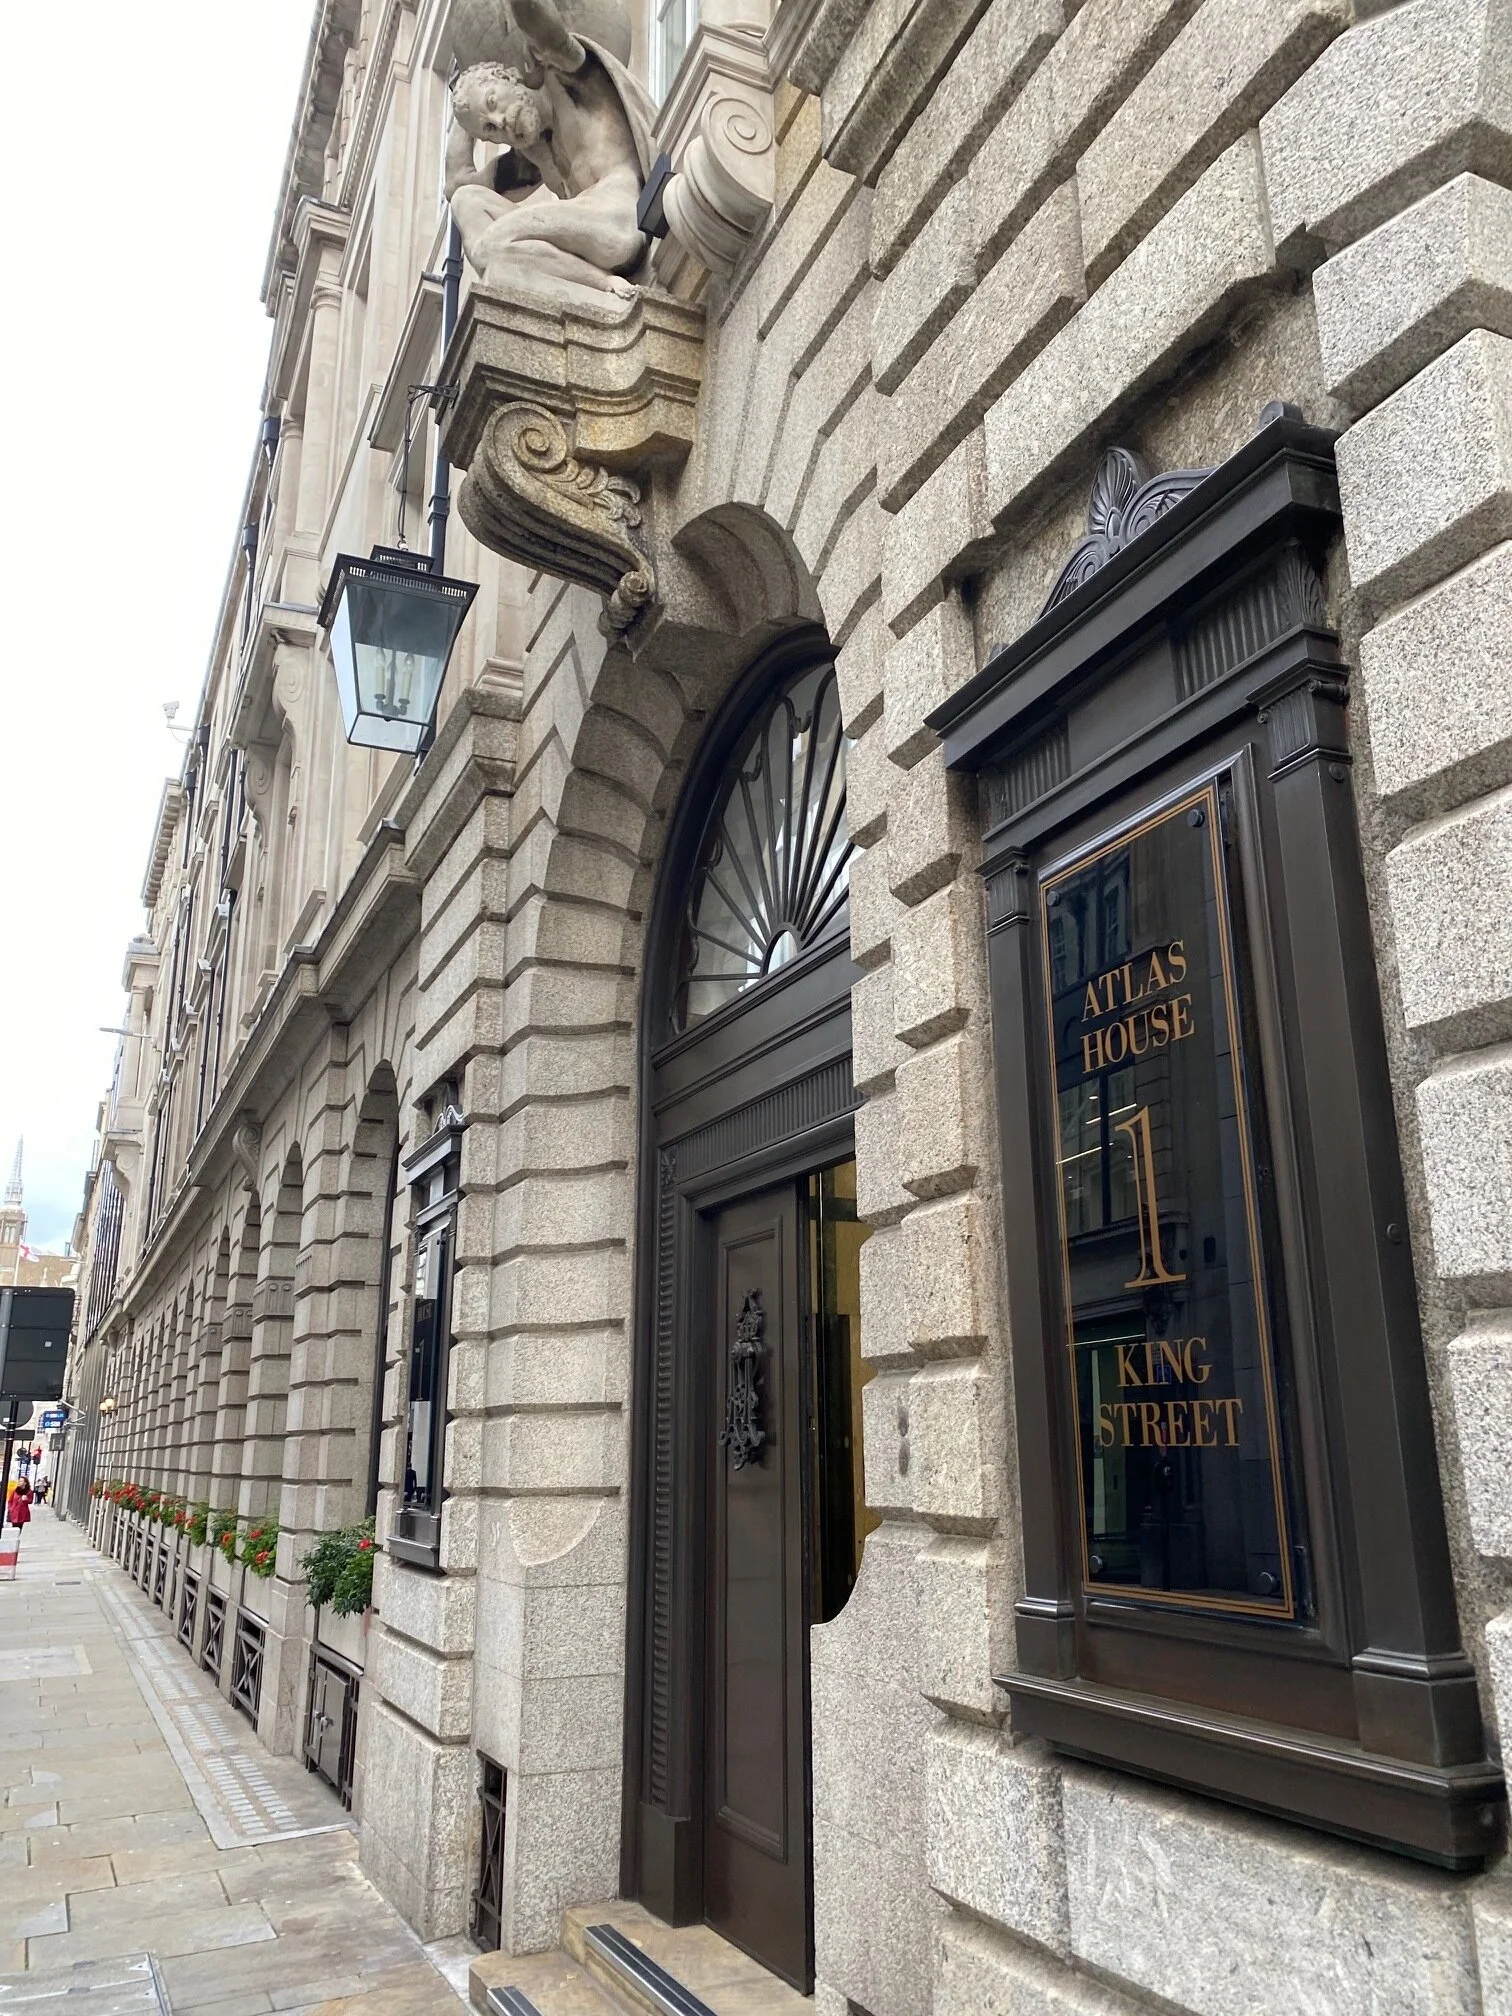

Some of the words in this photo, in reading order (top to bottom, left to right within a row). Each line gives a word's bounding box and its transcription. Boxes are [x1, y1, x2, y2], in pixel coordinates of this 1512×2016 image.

[1081, 940, 1187, 1022] ATLAS
[1081, 995, 1195, 1074] HOUSE
[1115, 1105, 1186, 1289] 1
[1115, 1337, 1212, 1388] KING
[1098, 1398, 1243, 1447] STREET
